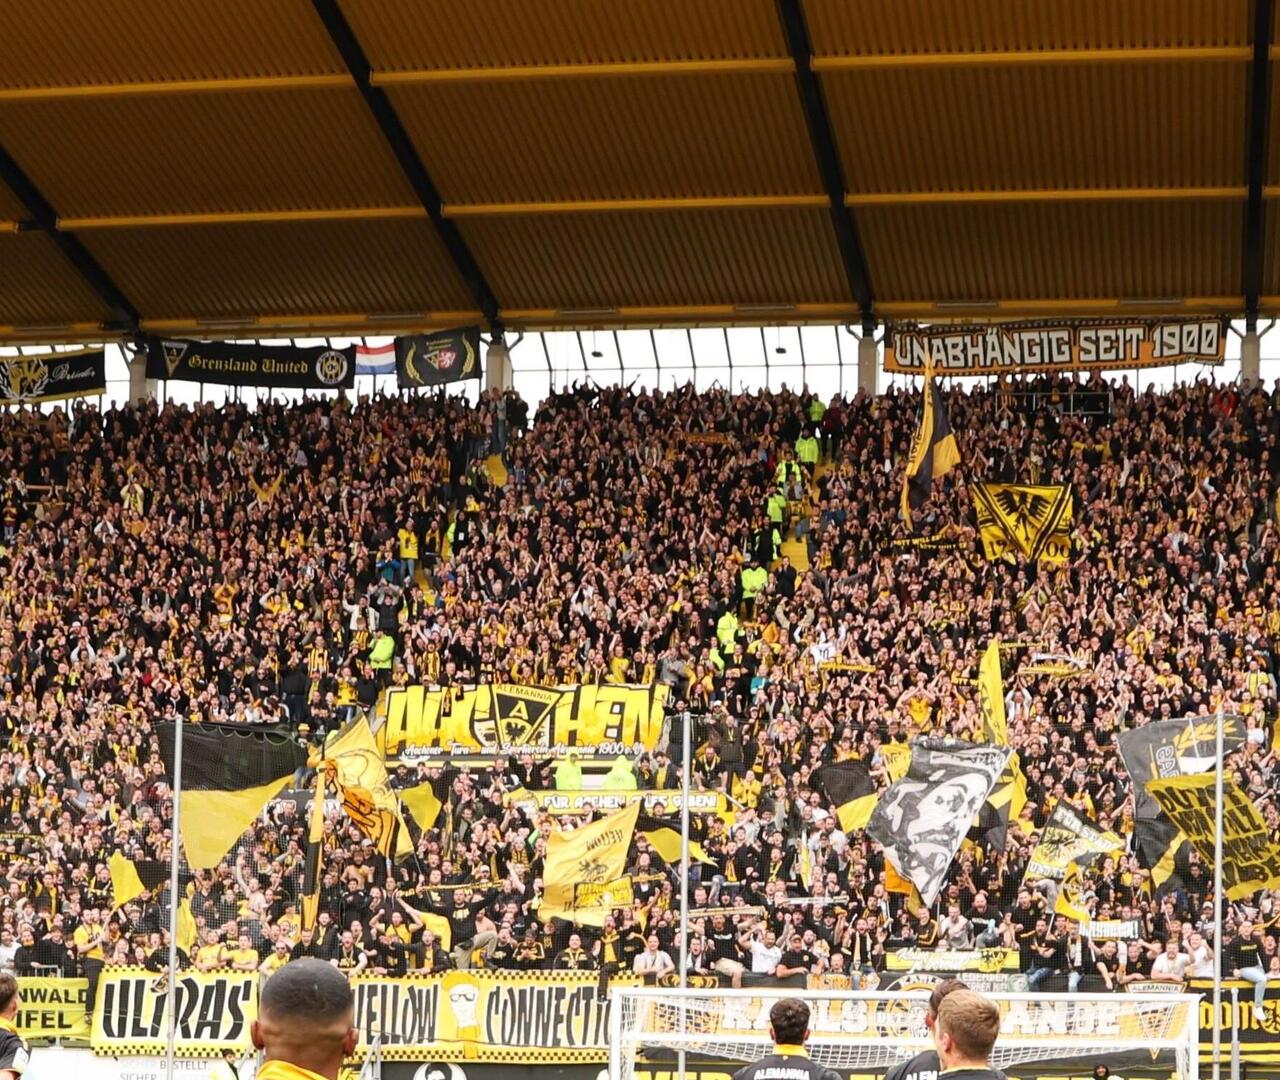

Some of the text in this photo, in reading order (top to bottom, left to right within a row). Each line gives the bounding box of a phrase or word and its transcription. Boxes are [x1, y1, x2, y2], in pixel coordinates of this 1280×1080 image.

[893, 322, 1218, 366] UNABHÄNGIG SEIT 1900
[188, 354, 308, 374] Grenzland United
[543, 795, 570, 810] FÜR
